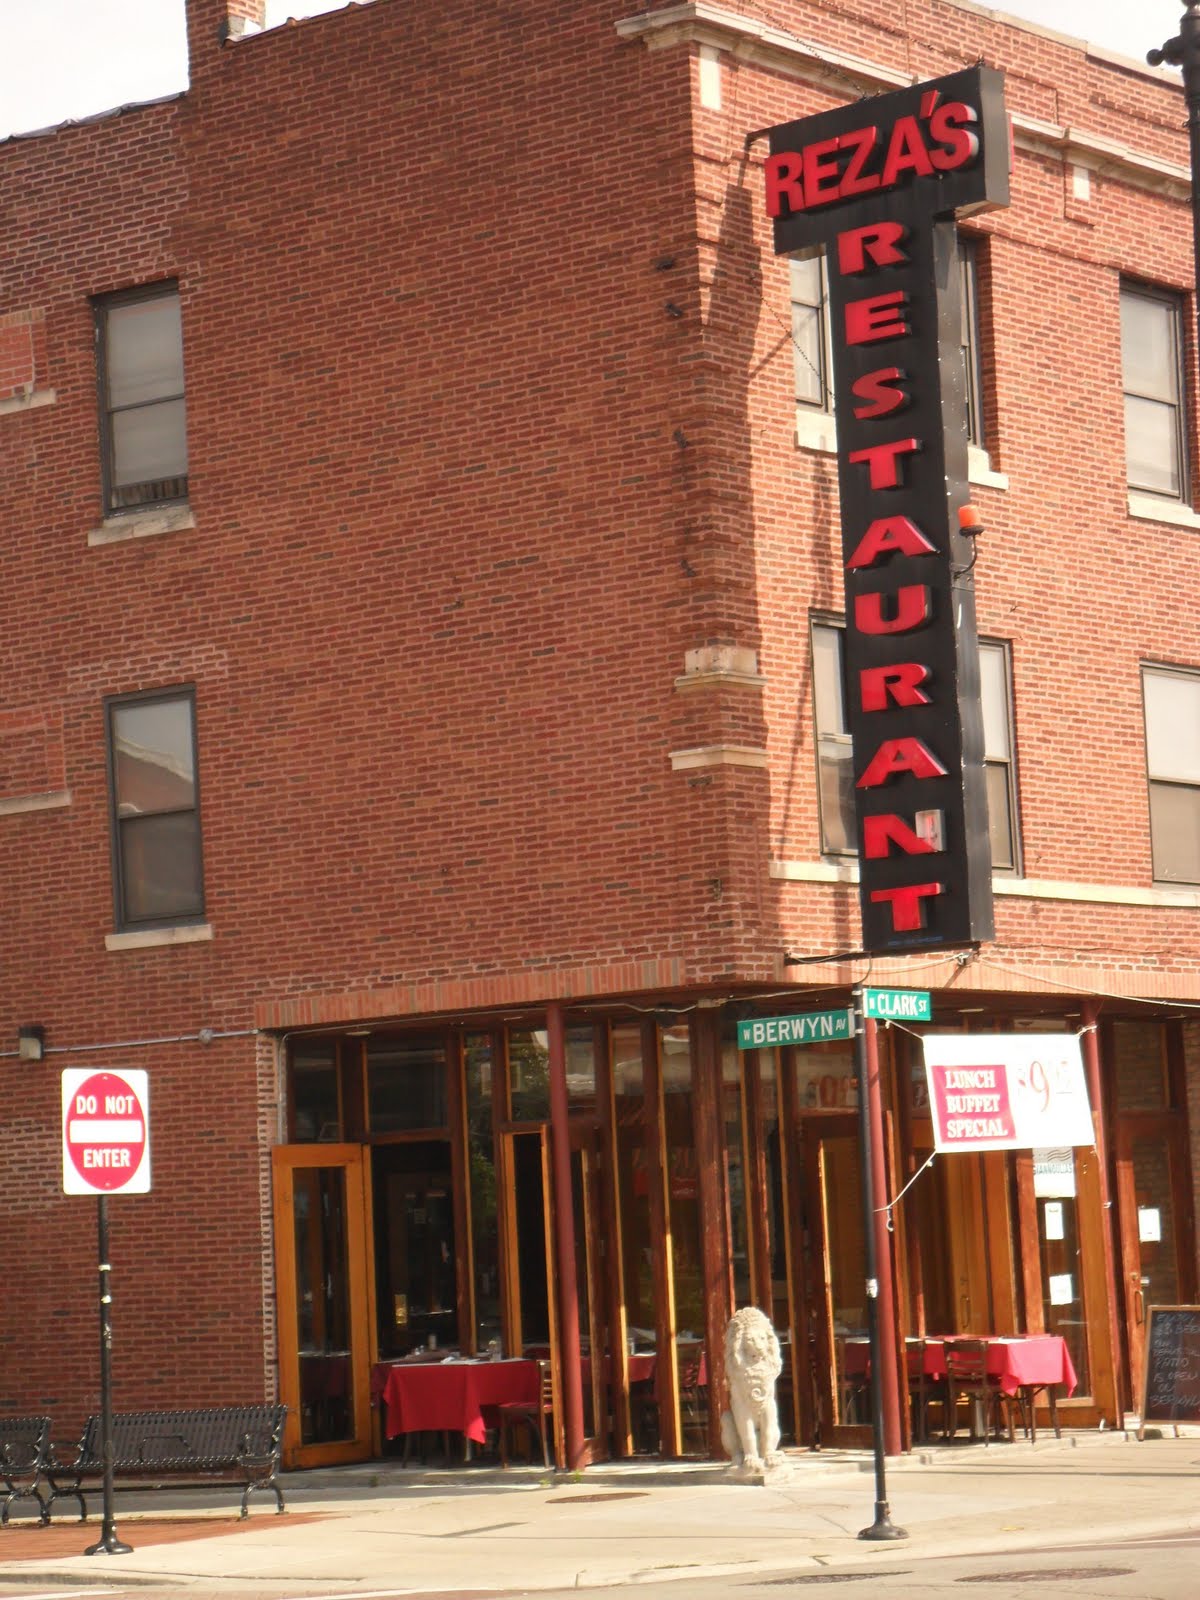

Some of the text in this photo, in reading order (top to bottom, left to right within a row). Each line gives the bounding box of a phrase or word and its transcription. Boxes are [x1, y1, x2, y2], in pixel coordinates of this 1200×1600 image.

[764, 90, 979, 217] REZA'S
[837, 221, 950, 931] RESTAURANT
[877, 994, 918, 1016] CLARK
[918, 1000, 927, 1013] ST
[743, 1015, 847, 1044] W BERWYN AV
[945, 1070, 996, 1089] LUNCH
[76, 1095, 135, 1115] DO NOT
[945, 1094, 1001, 1114] BUFFET
[946, 1118, 1009, 1138] SPECIAL
[83, 1148, 131, 1168] ENTER
